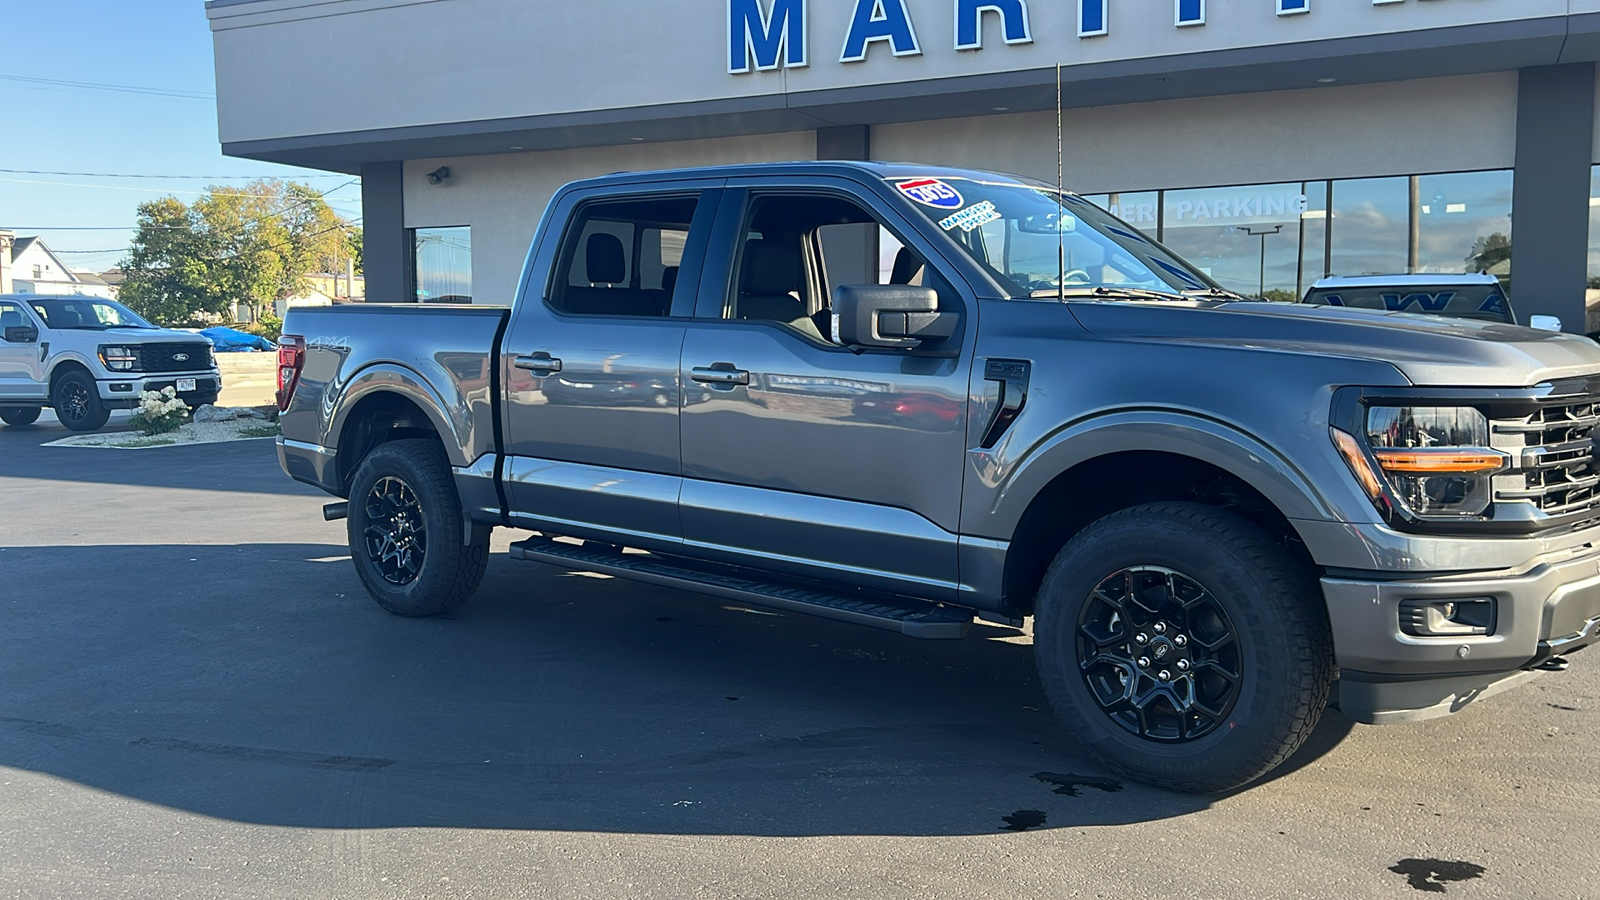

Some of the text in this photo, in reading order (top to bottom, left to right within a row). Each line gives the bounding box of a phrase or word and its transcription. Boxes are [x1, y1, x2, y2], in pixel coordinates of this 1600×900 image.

[910, 183, 956, 203] 2025
[1176, 193, 1308, 221] PARKING
[960, 210, 1001, 231] SPECIAL
